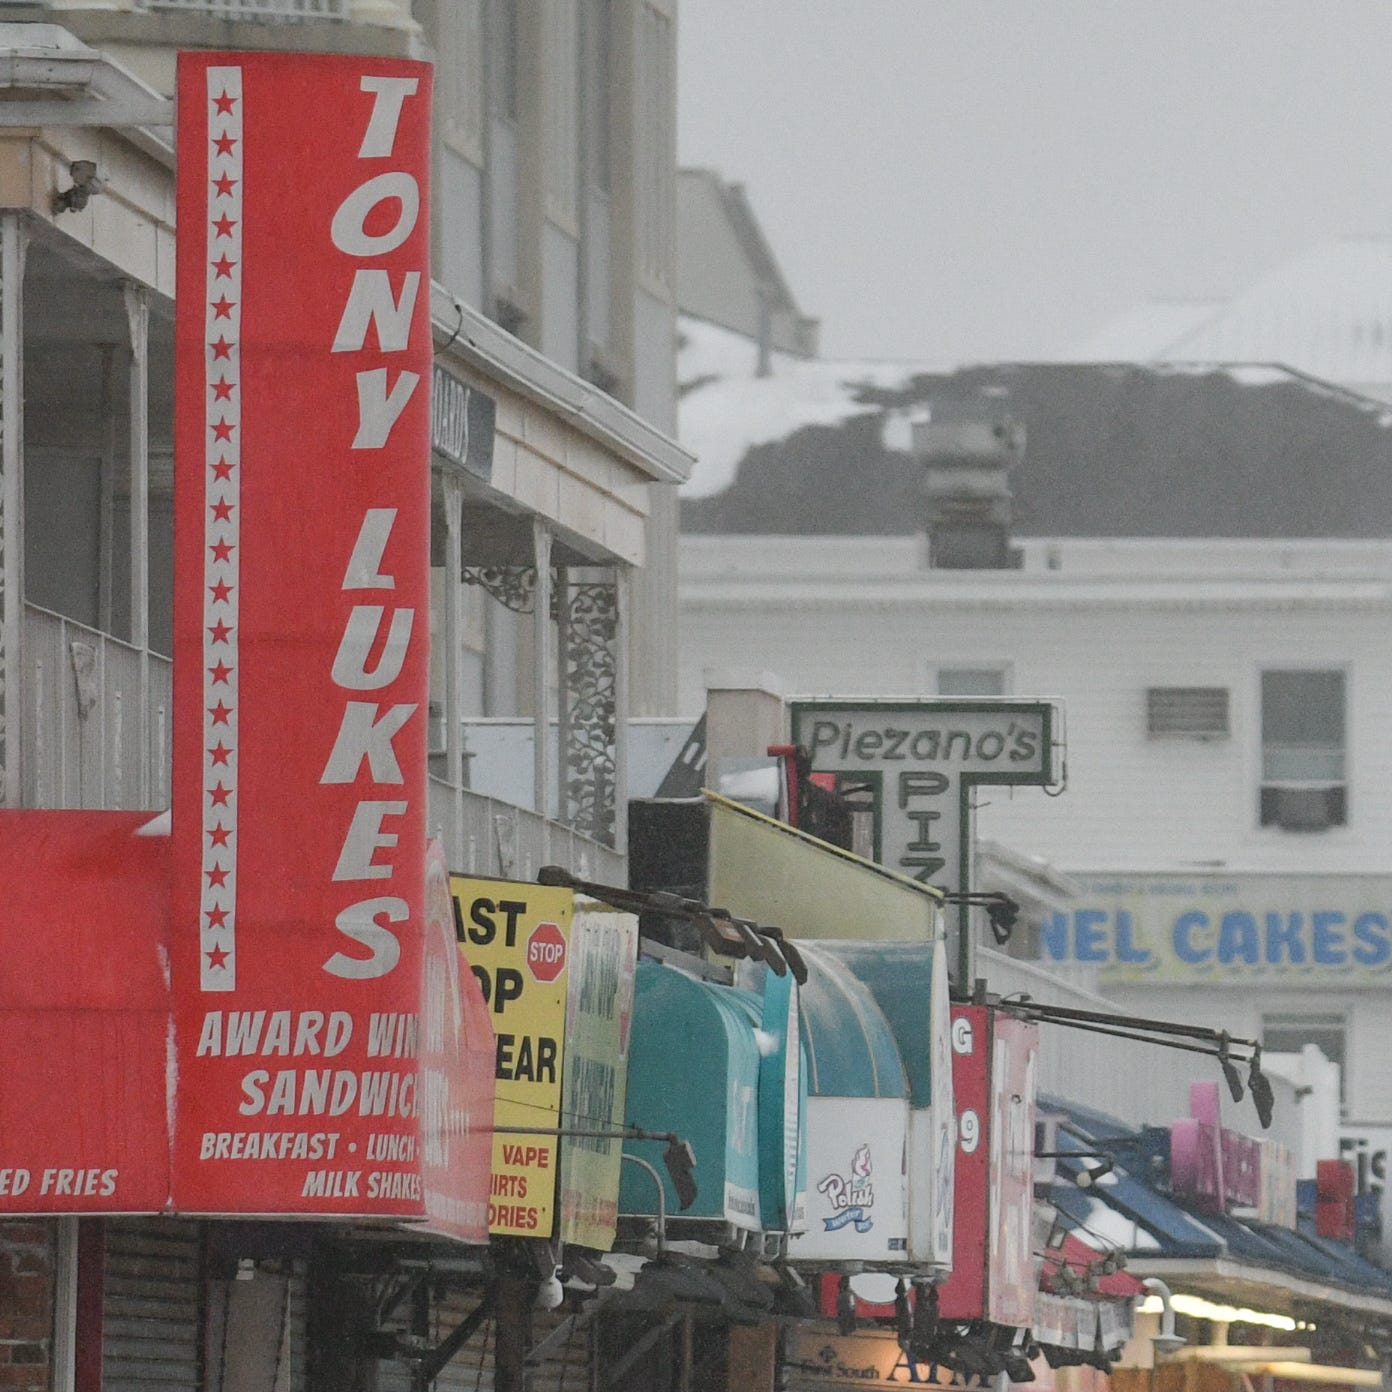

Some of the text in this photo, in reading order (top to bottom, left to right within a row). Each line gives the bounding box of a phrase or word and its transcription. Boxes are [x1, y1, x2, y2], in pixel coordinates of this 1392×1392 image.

[319, 75, 420, 980] TONY LUKES
[811, 721, 1037, 762] Piezano's
[530, 941, 563, 963] STOP
[1171, 910, 1392, 966] CAKES
[196, 1010, 354, 1058] AWARD
[200, 1132, 415, 1162] BREAKFAST LUNCH
[502, 1144, 549, 1168] VAPE
[0, 1168, 119, 1196] ED FRIES
[301, 1171, 422, 1201] MILK SHAKES
[818, 1173, 874, 1210] Polish
